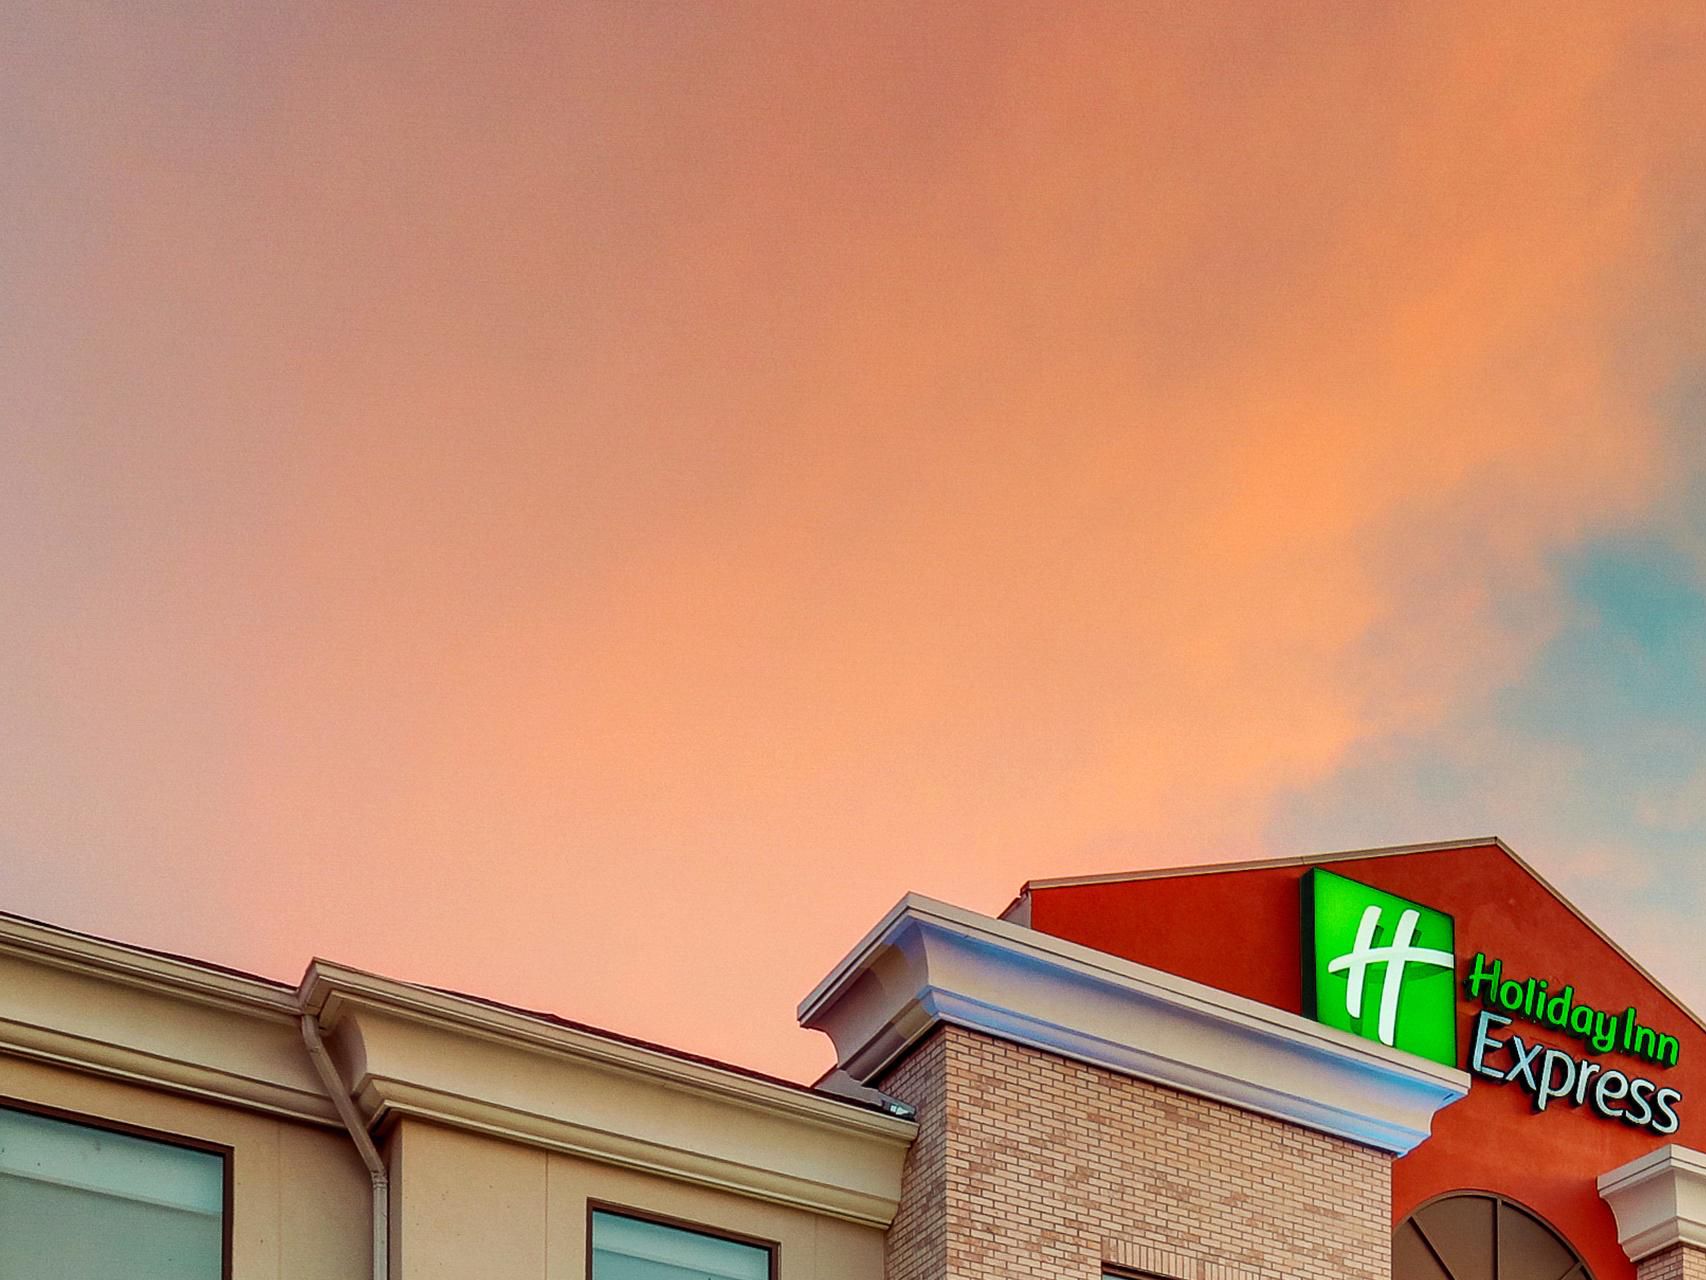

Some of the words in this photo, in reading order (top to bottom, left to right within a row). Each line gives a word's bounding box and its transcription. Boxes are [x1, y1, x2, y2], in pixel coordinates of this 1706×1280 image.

[1469, 952, 1617, 1053] Holiday
[1623, 1007, 1679, 1065] Inn
[1472, 1010, 1681, 1134] Express
